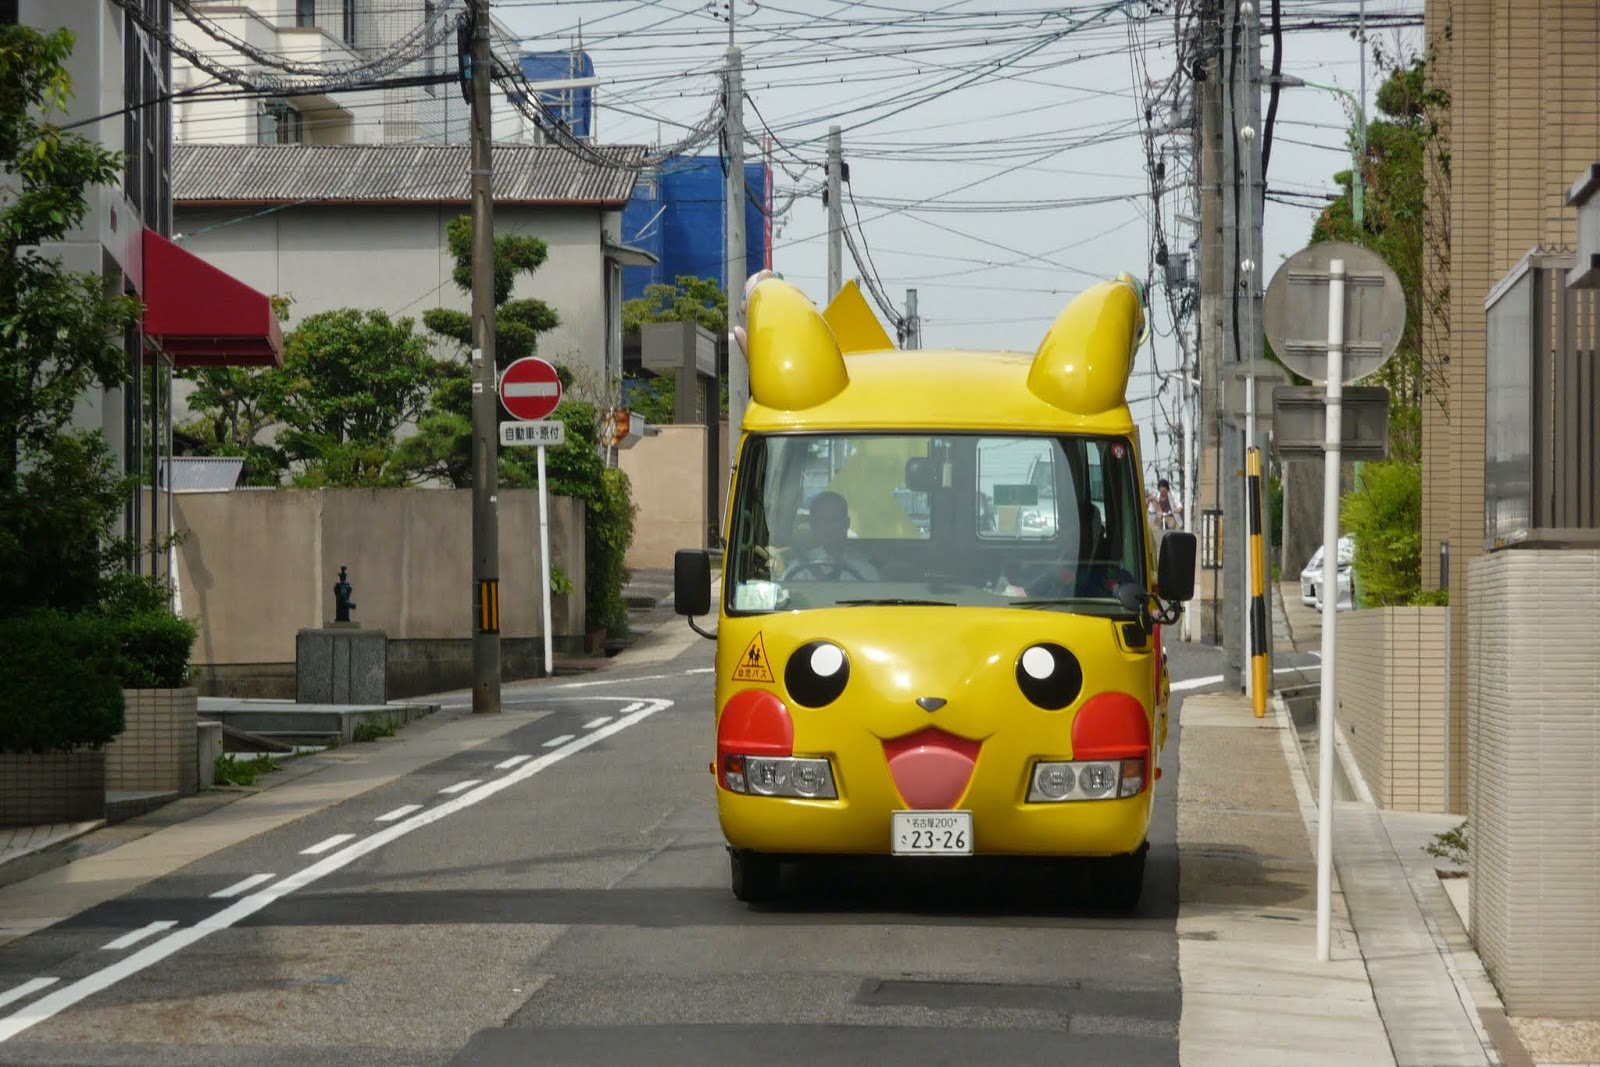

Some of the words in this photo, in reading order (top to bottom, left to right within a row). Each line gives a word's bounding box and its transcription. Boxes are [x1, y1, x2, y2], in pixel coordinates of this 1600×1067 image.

[505, 425, 559, 441] 自動車・原付
[911, 830, 965, 849] 23-26
